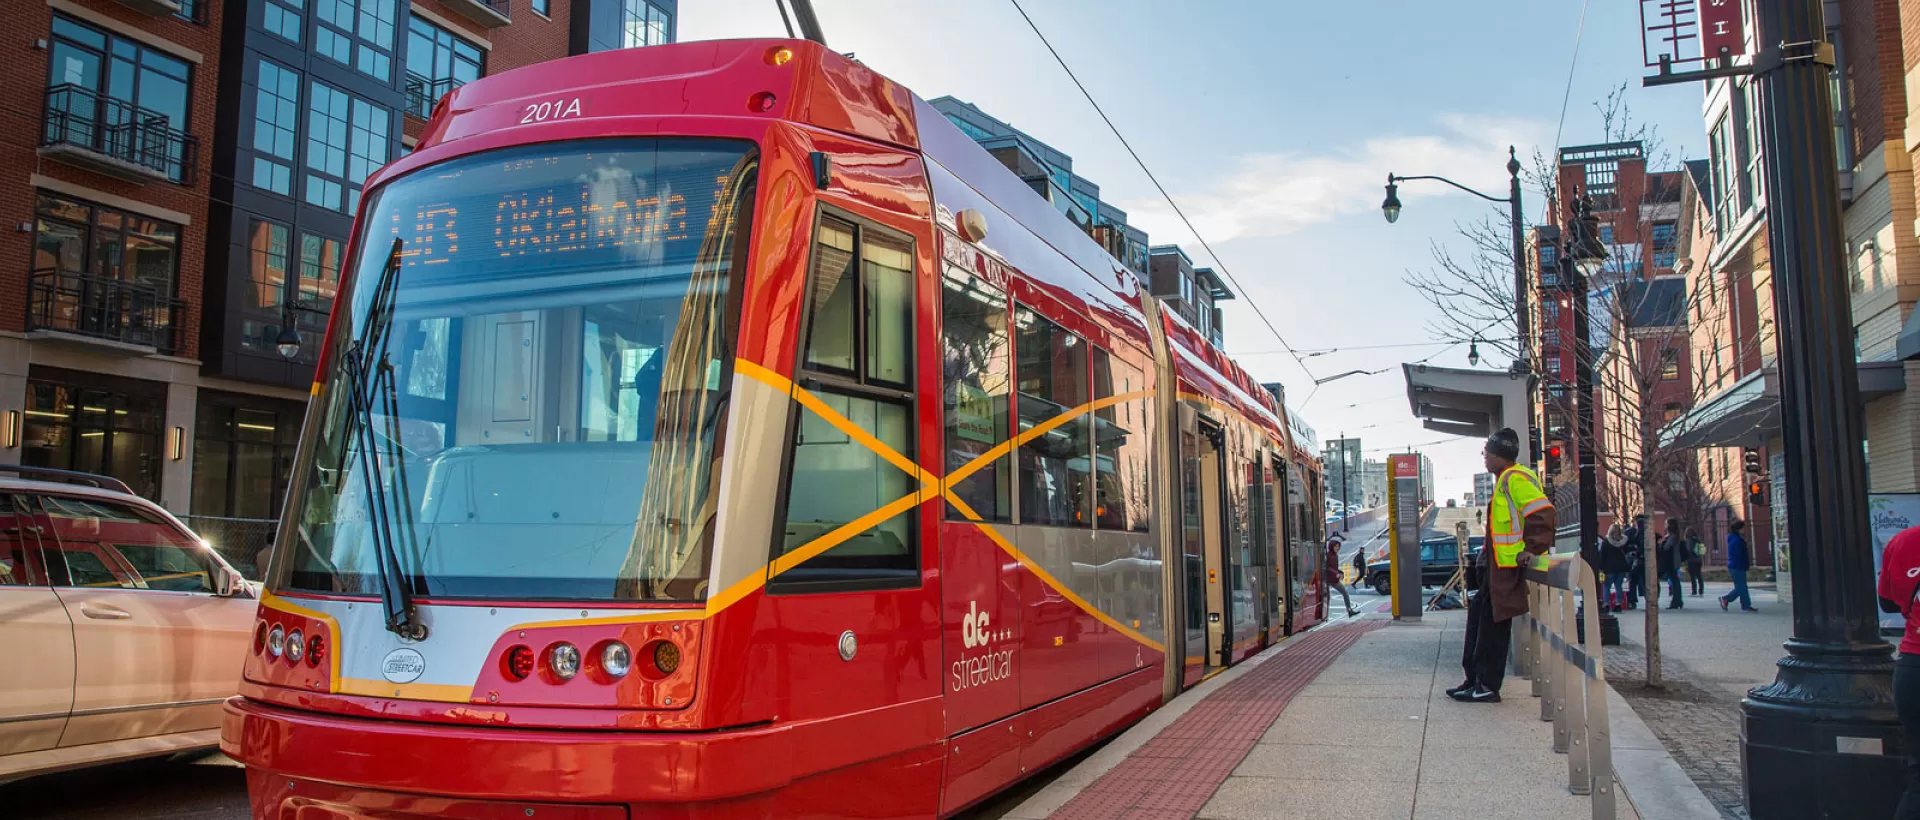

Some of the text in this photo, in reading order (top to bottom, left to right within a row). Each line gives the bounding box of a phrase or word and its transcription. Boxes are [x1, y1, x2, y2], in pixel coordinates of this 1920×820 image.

[521, 98, 581, 124] 201A
[496, 185, 687, 256] Oklahoma
[963, 601, 990, 648] dc
[952, 648, 1014, 691] streetcar
